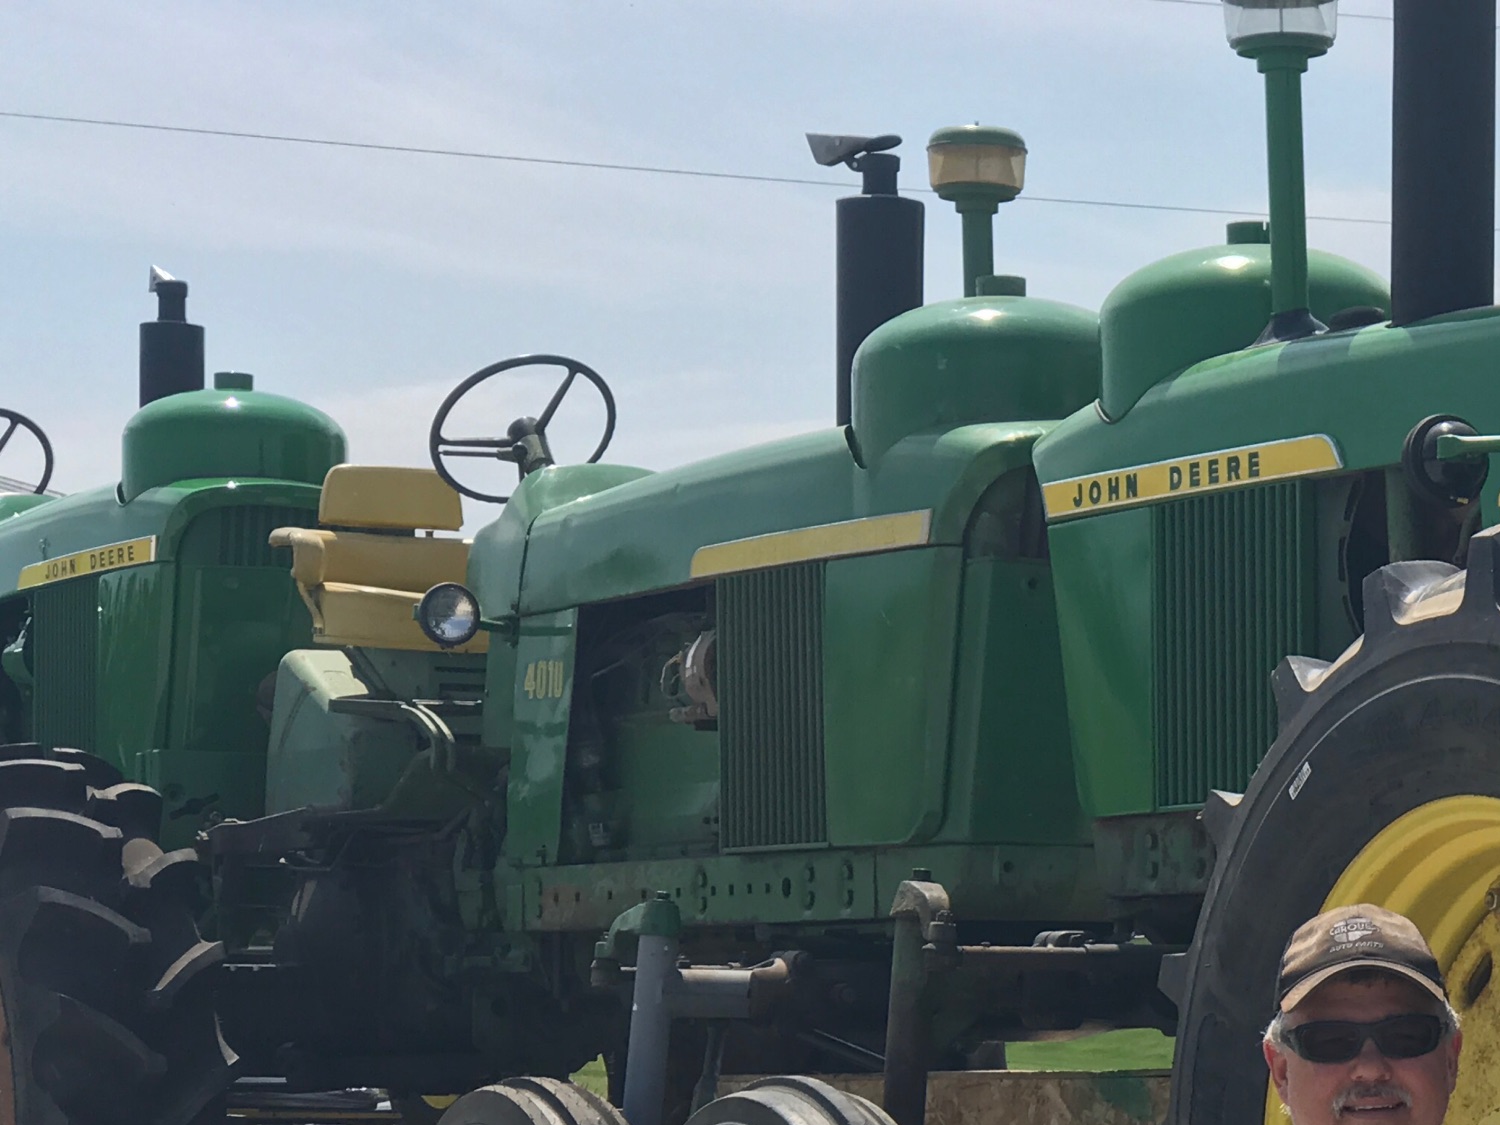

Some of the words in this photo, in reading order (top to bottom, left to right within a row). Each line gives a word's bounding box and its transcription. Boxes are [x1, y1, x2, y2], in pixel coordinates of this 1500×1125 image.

[1073, 473, 1138, 508] JOHN
[1169, 451, 1260, 492] DEERE
[45, 559, 76, 579] JOHN
[89, 545, 135, 571] DEERE
